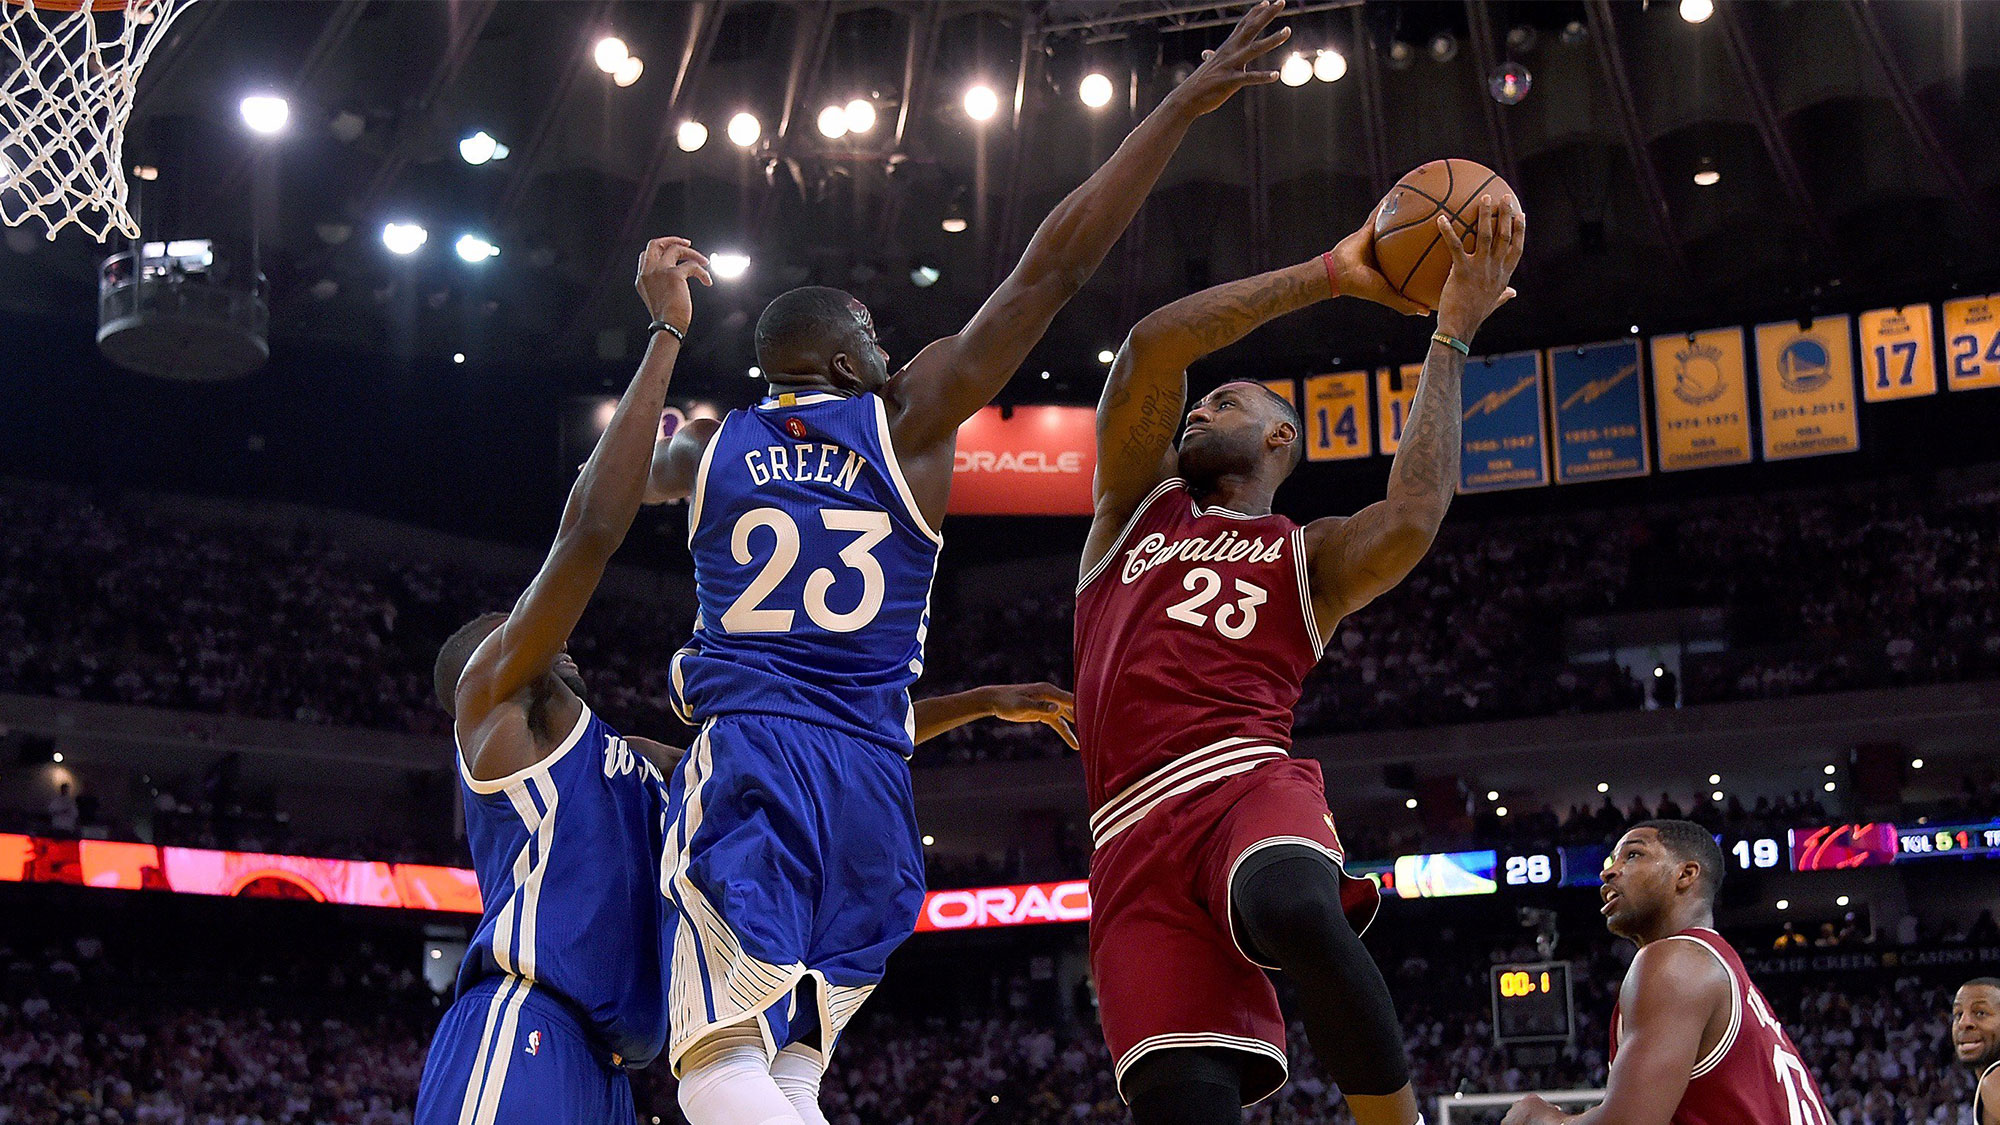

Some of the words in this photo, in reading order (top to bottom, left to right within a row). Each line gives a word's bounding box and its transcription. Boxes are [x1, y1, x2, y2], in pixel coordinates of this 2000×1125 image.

[1875, 341, 1917, 388] 17
[1317, 404, 1358, 448] 14
[745, 443, 867, 492] GREEN
[953, 451, 1081, 473] ORACLE
[720, 507, 893, 633] 23
[1121, 530, 1285, 585] Cavaliers
[1165, 567, 1268, 640] 23
[1506, 854, 1551, 885] 28
[1732, 838, 1778, 869] 19
